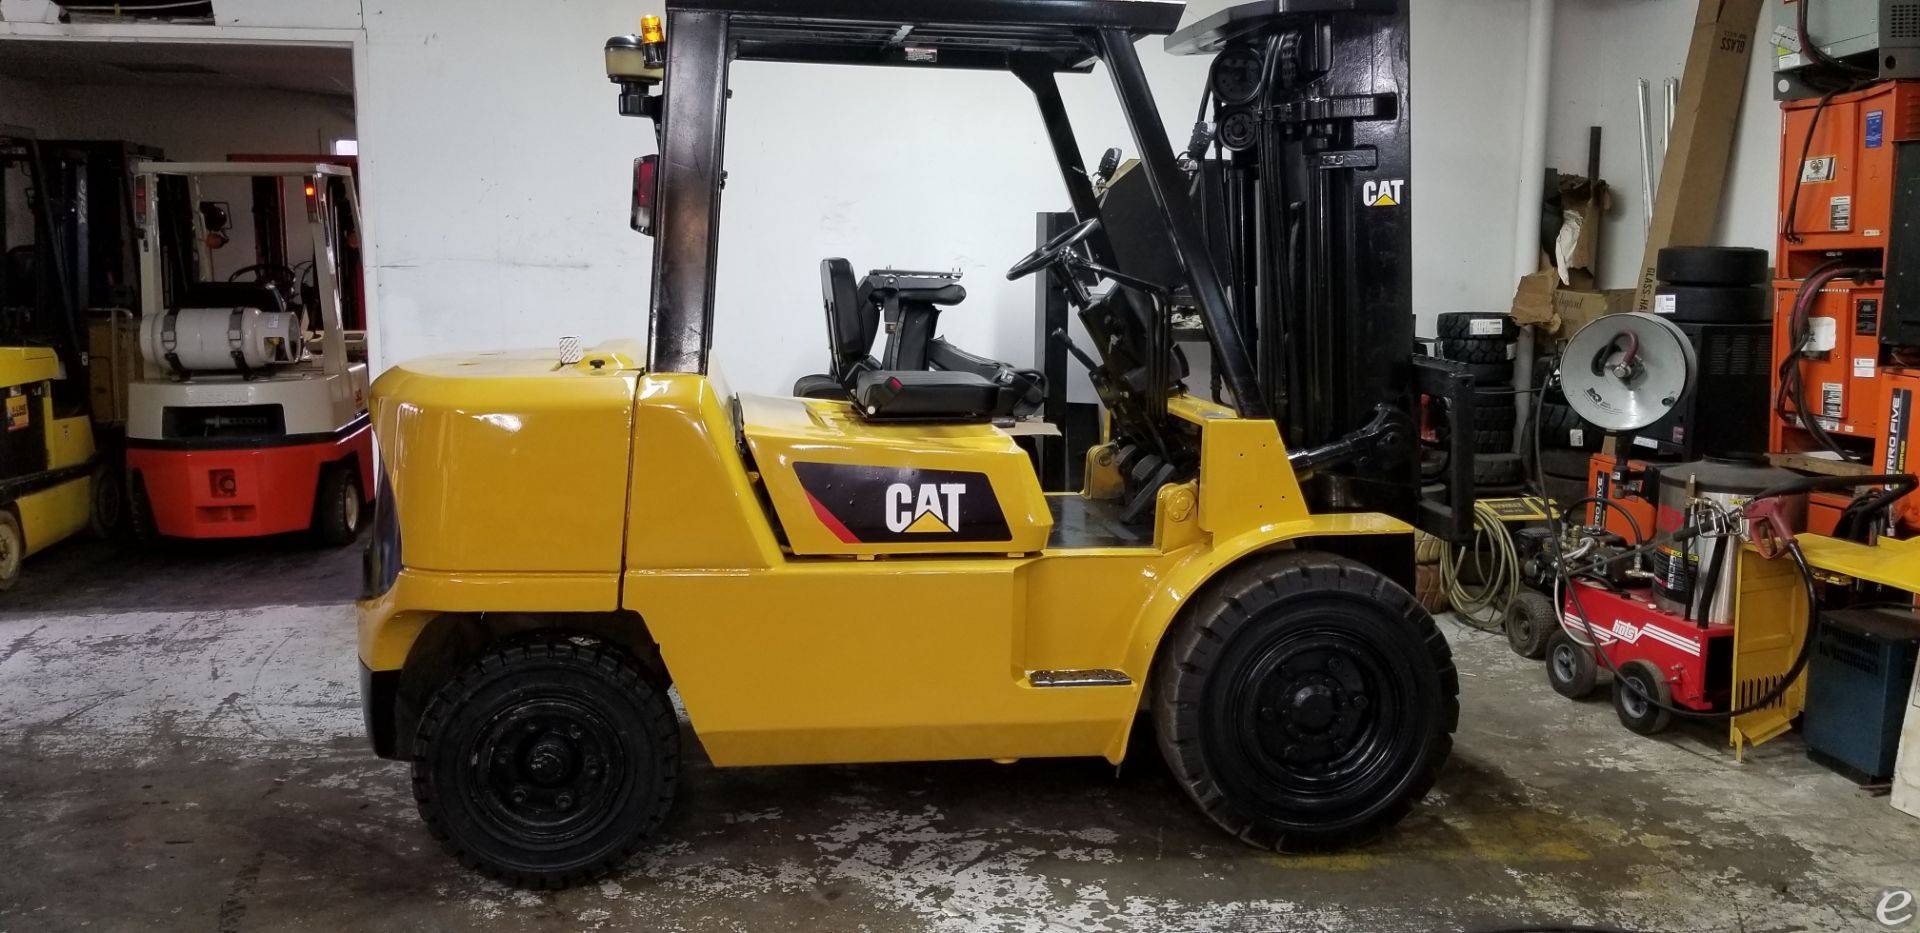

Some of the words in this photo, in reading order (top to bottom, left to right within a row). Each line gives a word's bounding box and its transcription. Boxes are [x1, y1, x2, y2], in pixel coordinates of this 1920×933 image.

[1720, 37, 1745, 53] GLASS
[1363, 180, 1404, 206] CAT
[1639, 267, 1655, 311] GLASS-HA
[1890, 397, 1901, 433] FIVE
[886, 484, 966, 533] CAT
